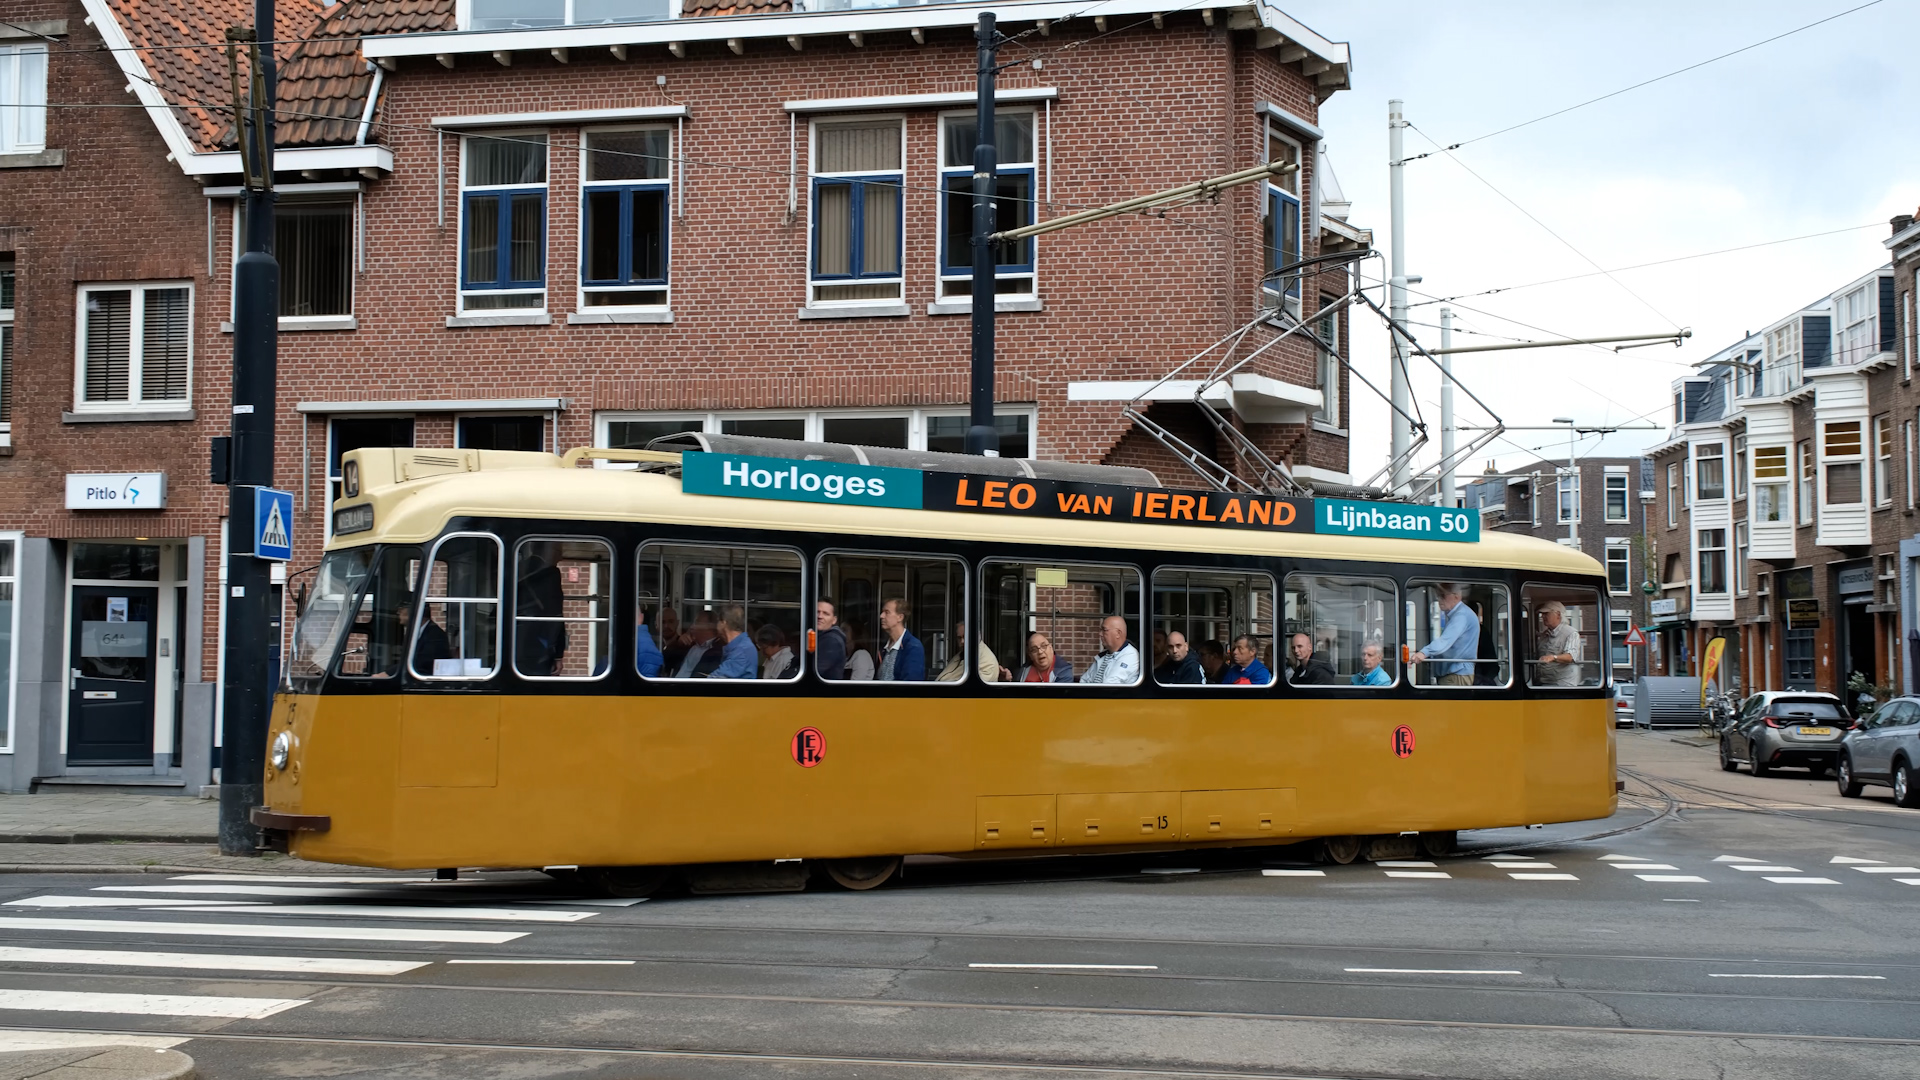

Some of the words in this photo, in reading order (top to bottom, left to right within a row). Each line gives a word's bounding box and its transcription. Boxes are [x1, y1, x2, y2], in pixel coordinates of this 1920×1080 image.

[346, 464, 358, 492] 14
[723, 461, 886, 499] Horloges
[86, 487, 117, 500] Pitlo
[955, 479, 1037, 510] LEO
[1057, 492, 1113, 516] VAN
[1132, 491, 1297, 527] IERLAND
[1326, 504, 1431, 532] Lijnbaan
[1439, 513, 1469, 534] 50
[1157, 815, 1168, 830] 15
